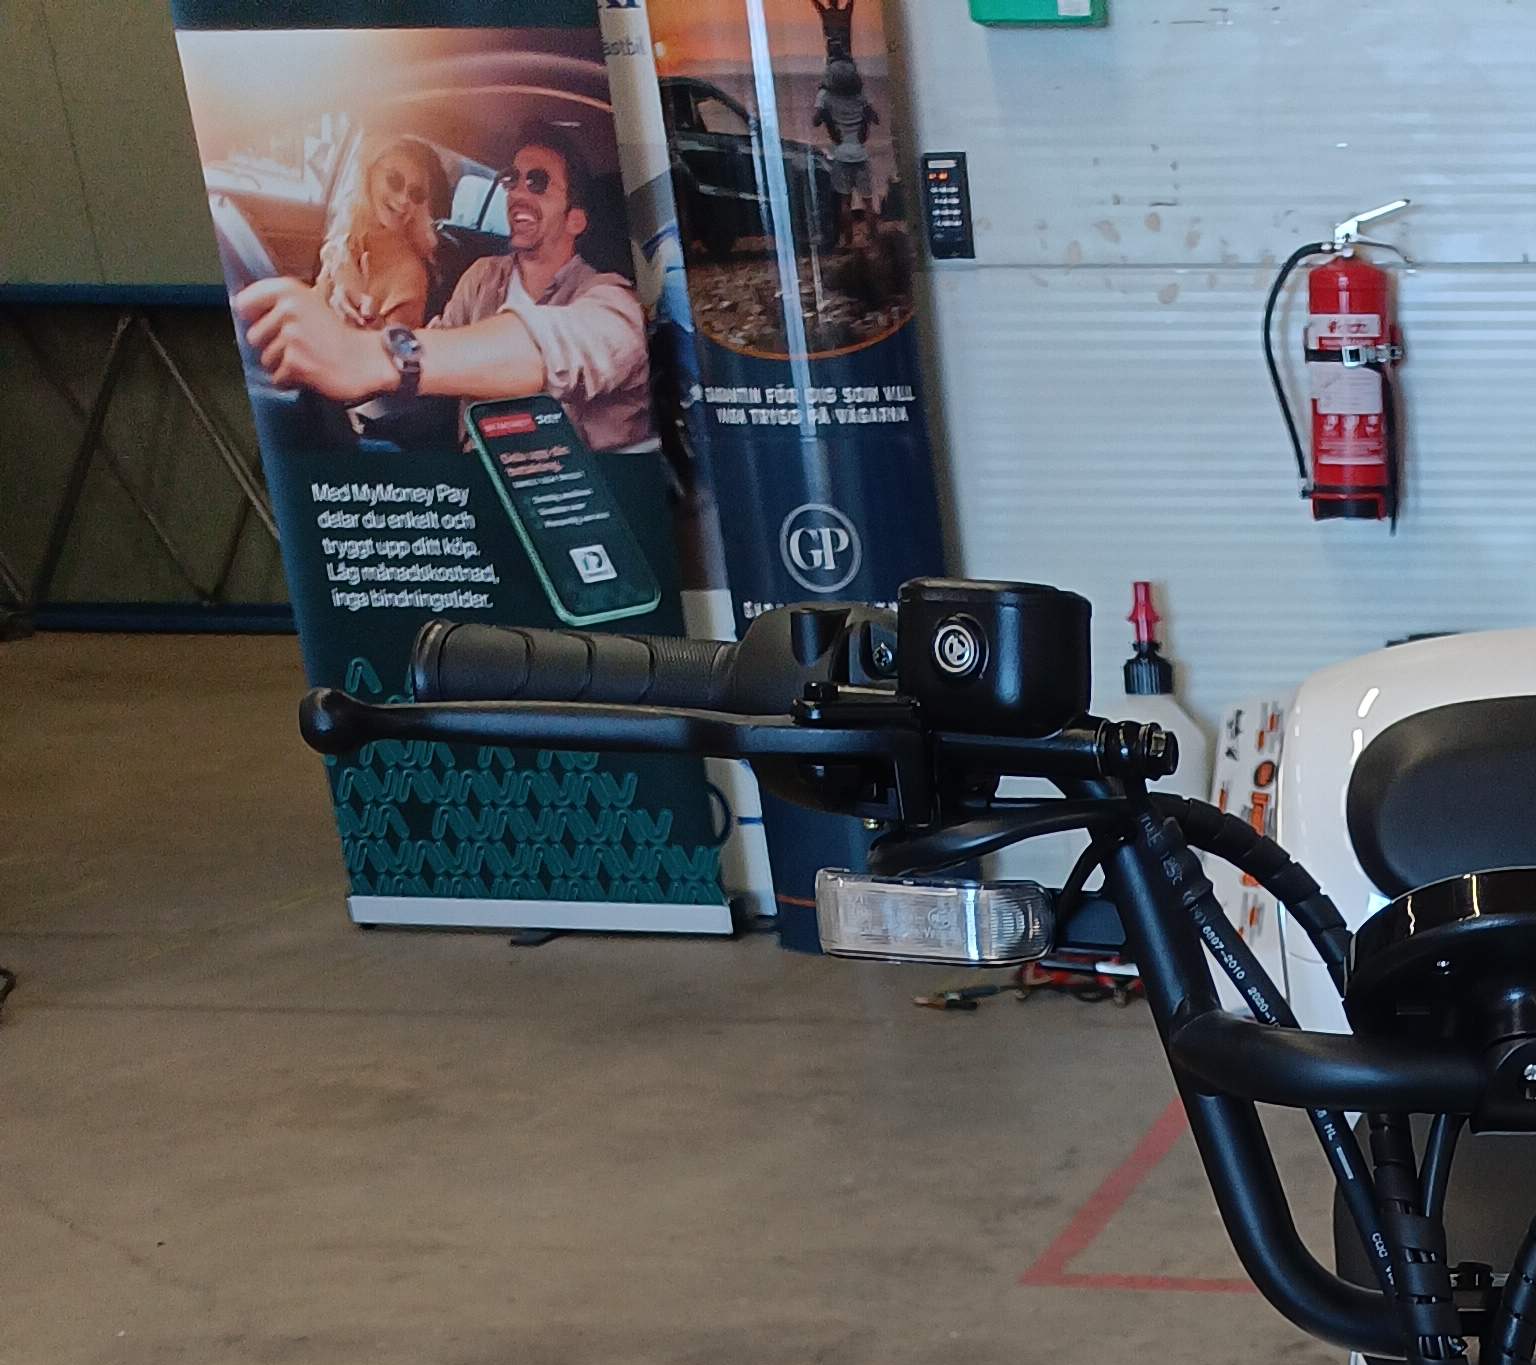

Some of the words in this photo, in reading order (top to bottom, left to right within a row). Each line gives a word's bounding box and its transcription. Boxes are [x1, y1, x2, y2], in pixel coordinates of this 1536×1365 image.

[842, 387, 880, 403] SOM
[883, 385, 916, 401] VILL
[749, 408, 801, 425] TRYGG
[806, 404, 831, 424] PÅ
[311, 483, 351, 502] Med
[352, 483, 435, 507] MyMoney
[435, 484, 470, 507] Pay
[317, 510, 360, 529] delar
[362, 510, 386, 529] du
[387, 511, 440, 529] enkelt
[441, 511, 476, 529] och
[322, 537, 375, 559] tryggt
[376, 539, 410, 559] upp
[412, 537, 441, 556] ditt
[442, 537, 481, 560] köp.
[789, 528, 849, 570] GP
[326, 562, 360, 585] Låg
